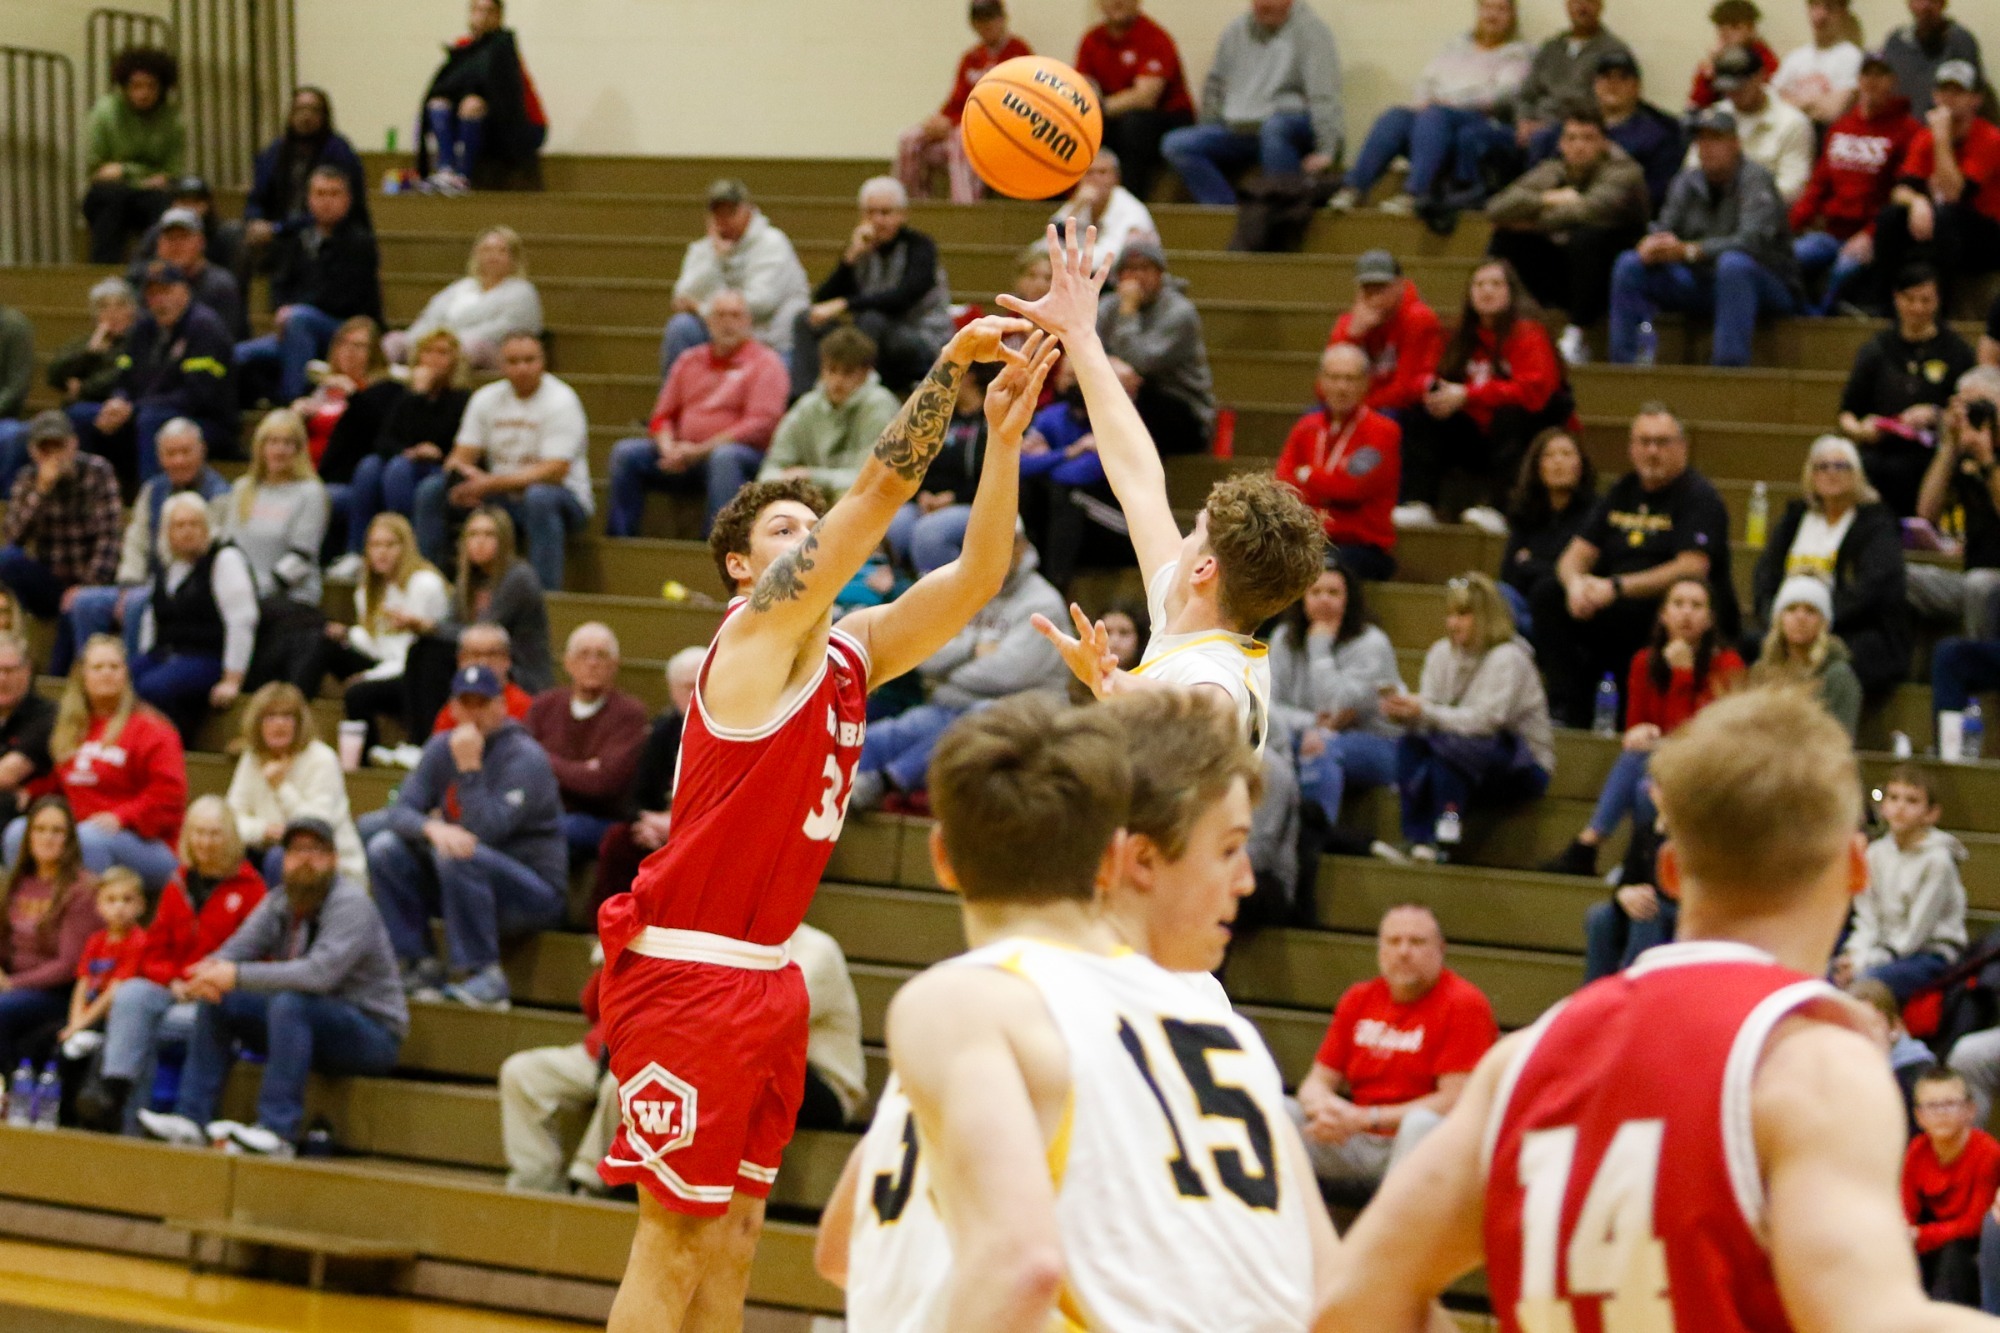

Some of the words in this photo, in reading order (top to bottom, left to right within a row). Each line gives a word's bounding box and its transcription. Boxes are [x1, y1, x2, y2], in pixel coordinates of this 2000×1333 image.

[1001, 89, 1078, 163] Wilson
[1034, 68, 1092, 116] NCAA
[1116, 1012, 1280, 1213] 15
[1514, 1118, 1677, 1333] 14
